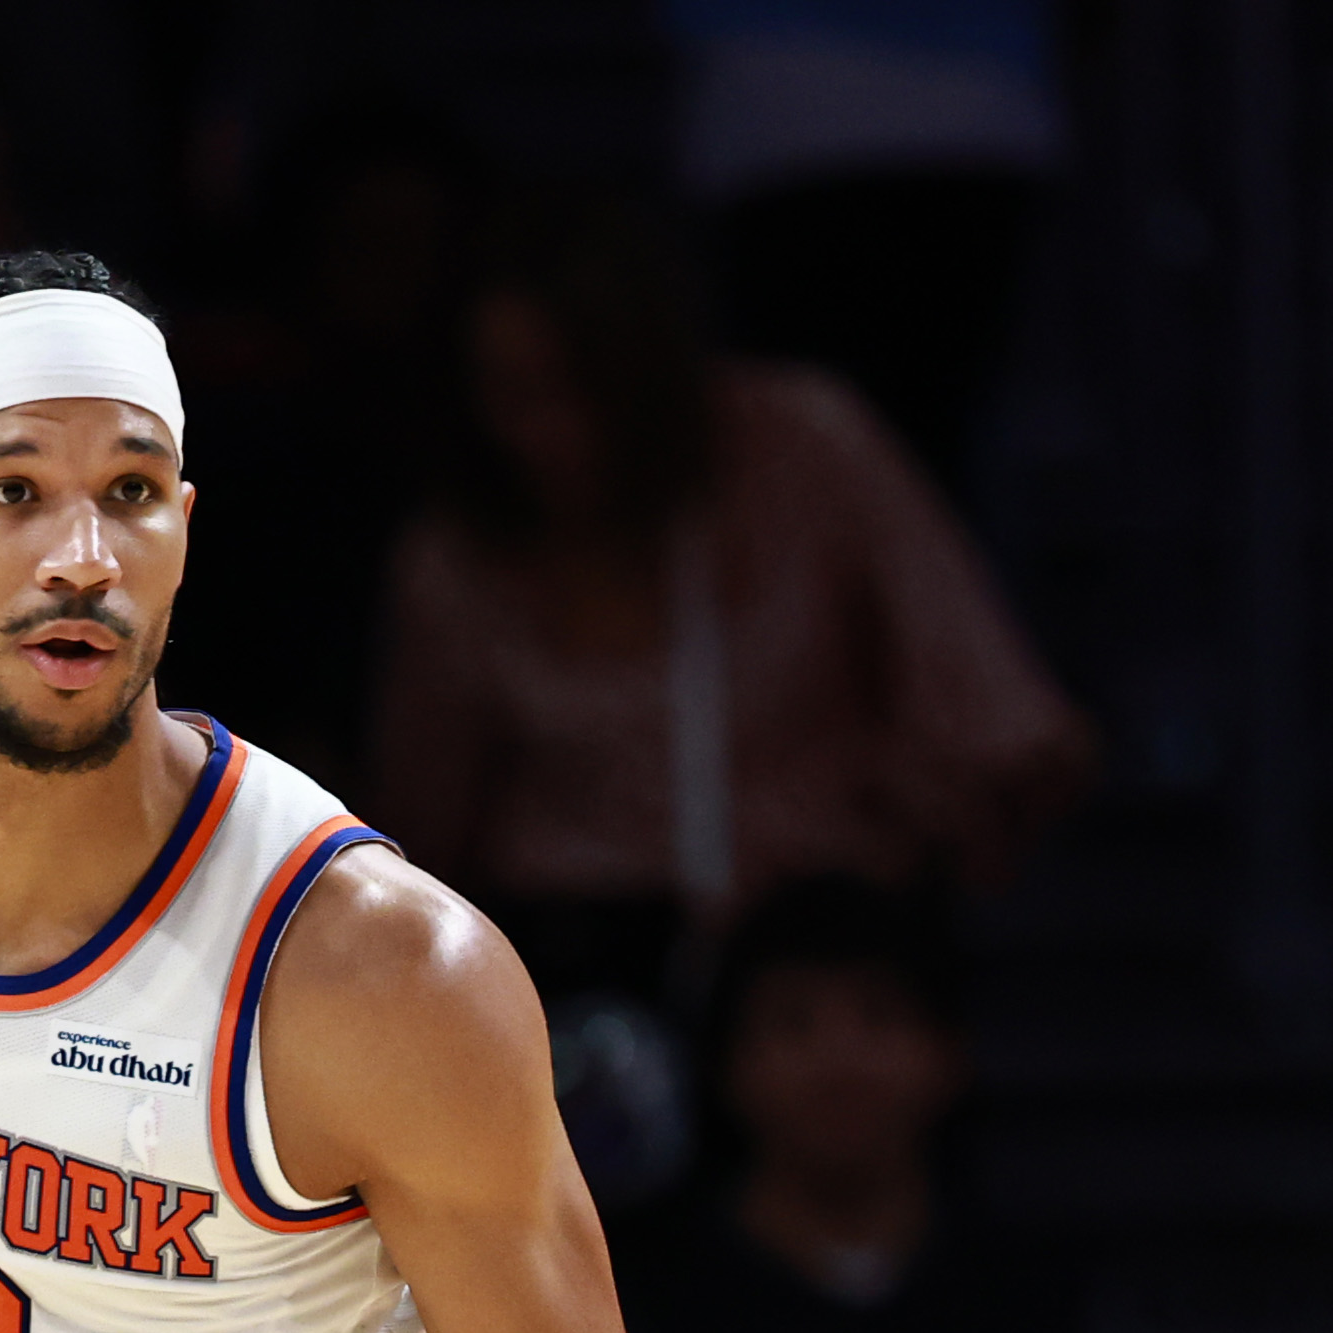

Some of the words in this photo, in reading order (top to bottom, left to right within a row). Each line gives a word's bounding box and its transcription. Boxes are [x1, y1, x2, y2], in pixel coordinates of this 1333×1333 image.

[57, 1030, 131, 1050] experience
[51, 1046, 105, 1073] abu
[109, 1054, 194, 1087] dhabi
